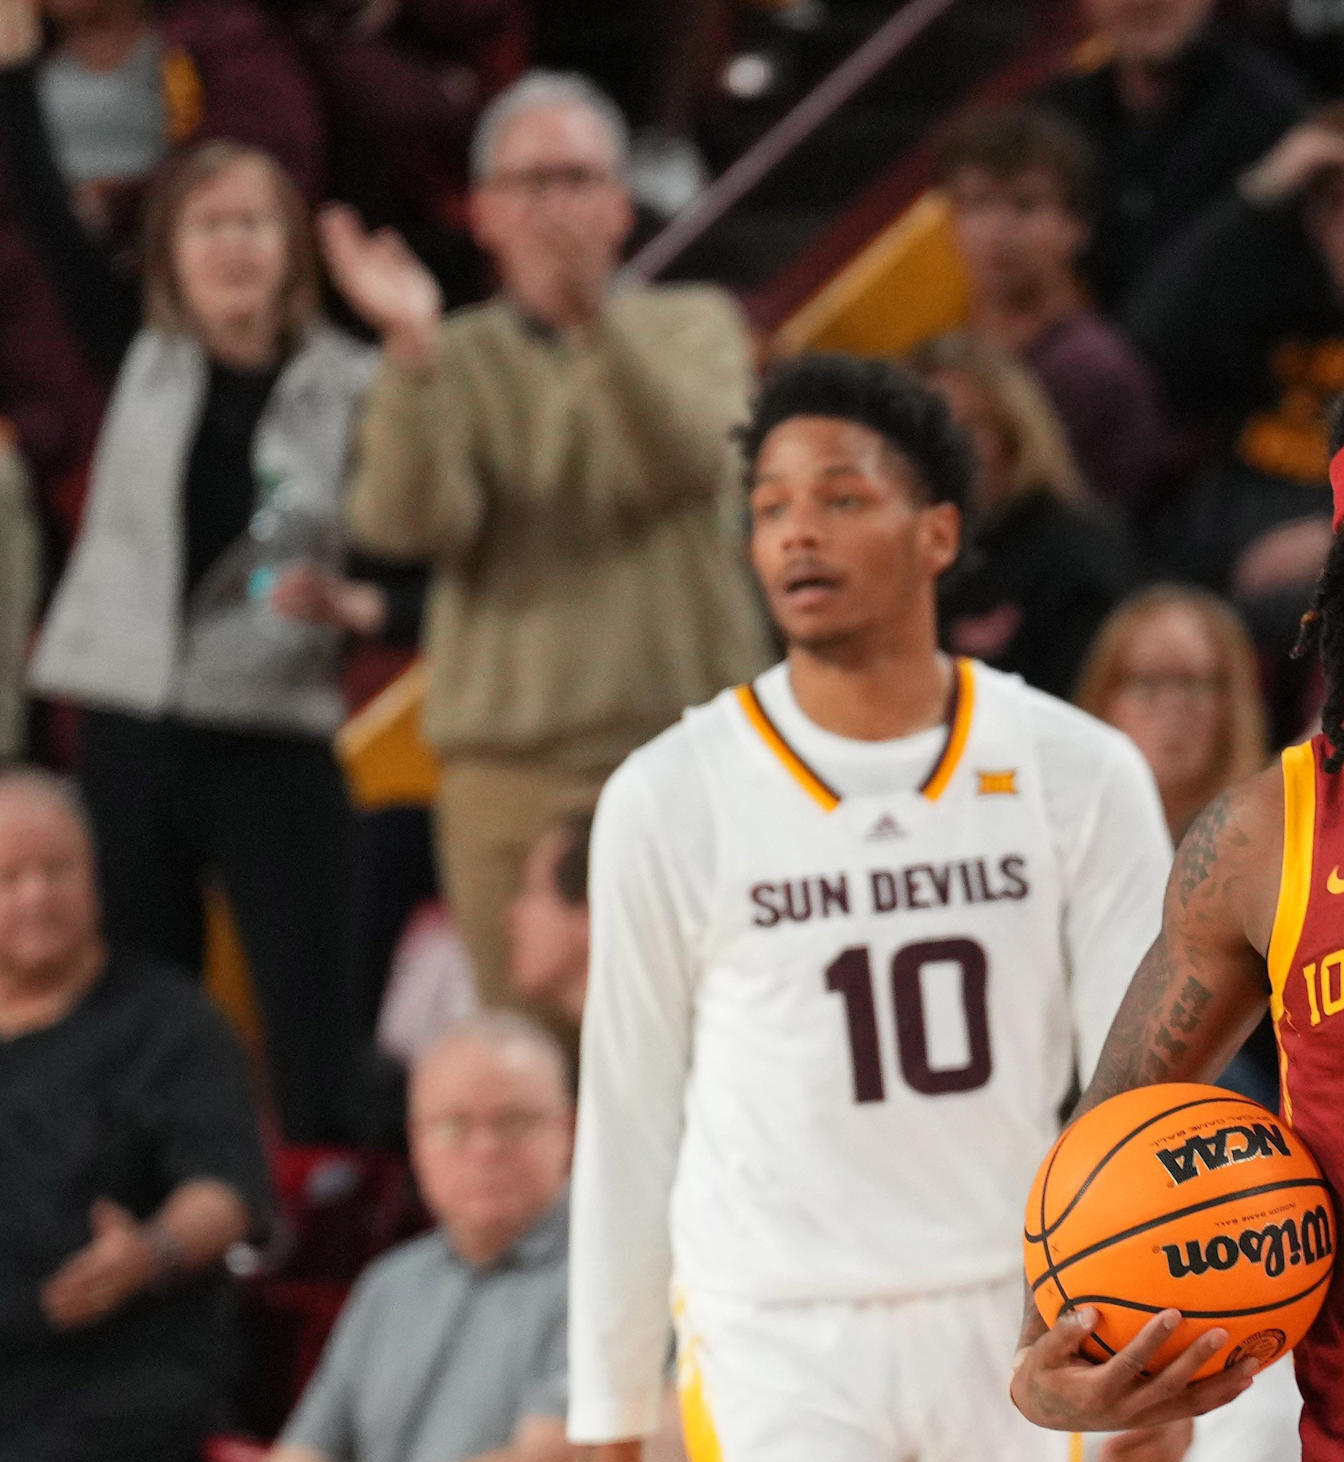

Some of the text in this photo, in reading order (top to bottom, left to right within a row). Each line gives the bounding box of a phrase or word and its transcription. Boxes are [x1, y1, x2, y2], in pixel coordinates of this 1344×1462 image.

[750, 854, 1031, 928] SUN DEVILS
[823, 936, 993, 1104] 10
[1155, 1123, 1292, 1186] NCAA
[1161, 1204, 1332, 1279] Wilson
